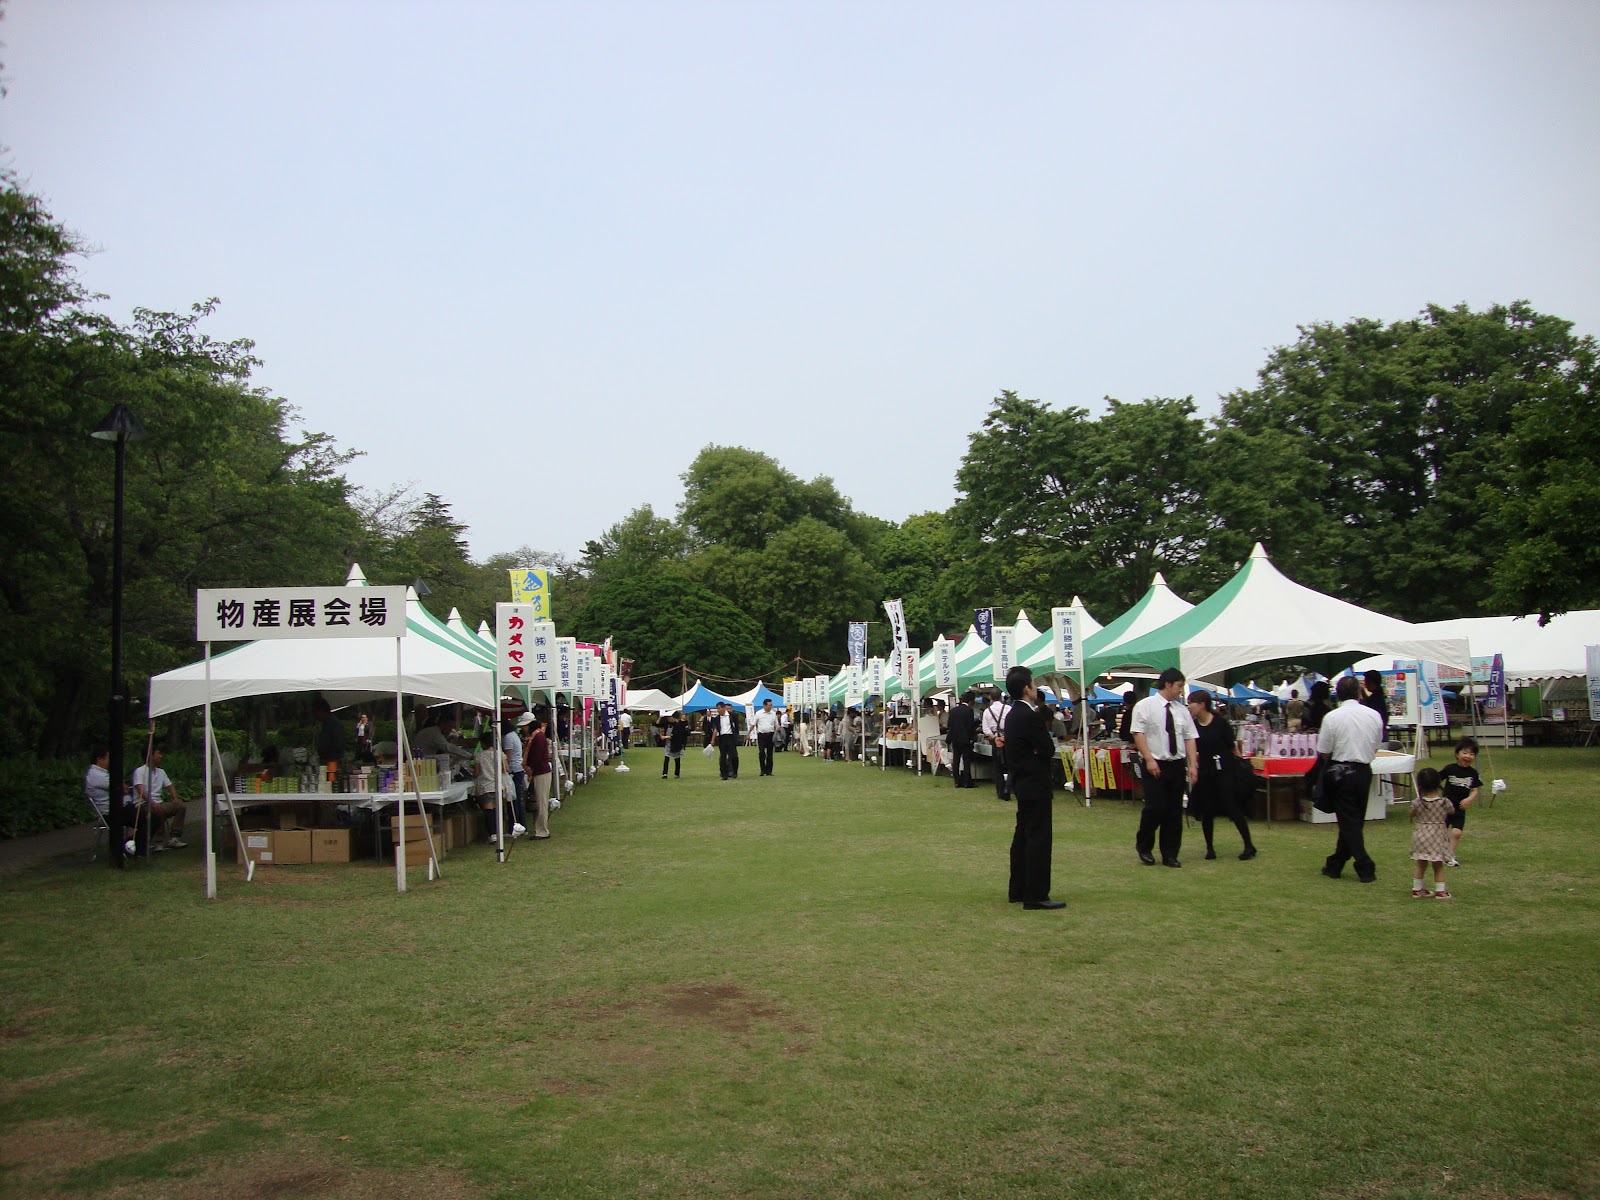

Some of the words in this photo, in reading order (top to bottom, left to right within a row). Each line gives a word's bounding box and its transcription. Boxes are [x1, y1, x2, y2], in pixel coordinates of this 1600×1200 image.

[217, 597, 387, 628] 物産展会場
[508, 616, 524, 679] カメヤマ
